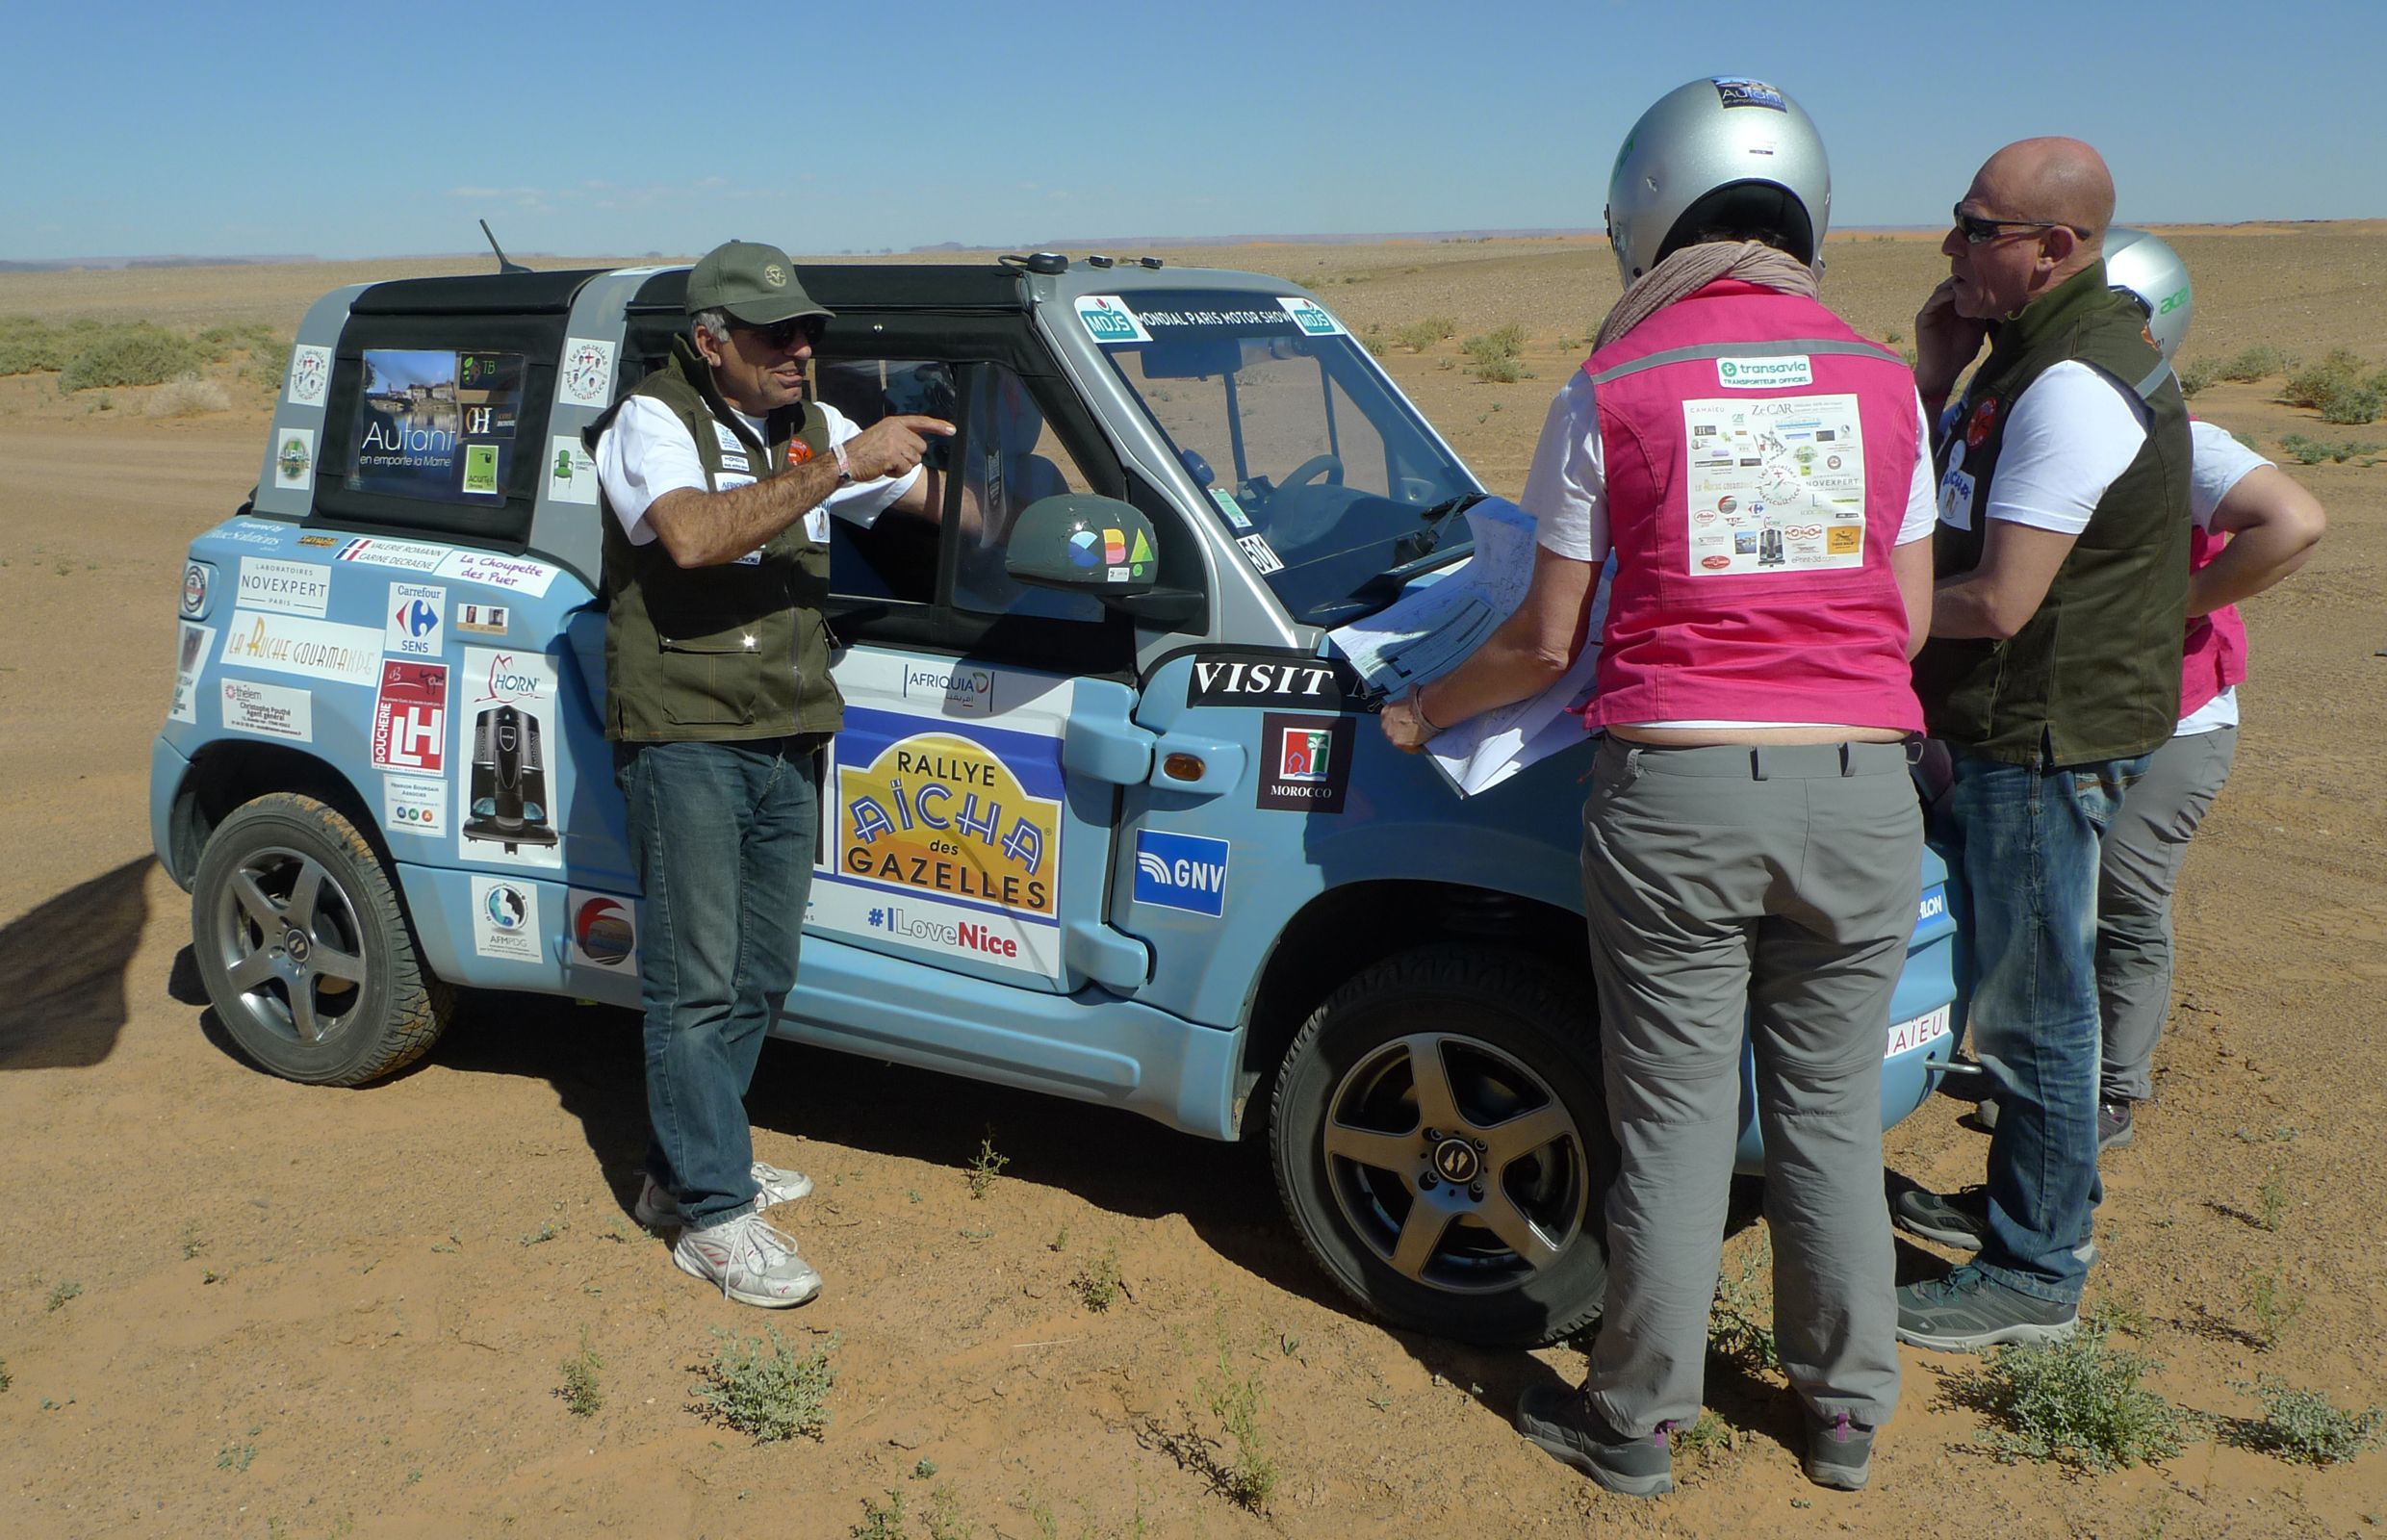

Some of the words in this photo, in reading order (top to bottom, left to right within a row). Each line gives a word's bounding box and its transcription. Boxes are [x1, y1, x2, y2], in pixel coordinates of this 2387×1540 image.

[1086, 315, 1131, 333] MDJS
[1134, 312, 1189, 327] MONDIAL
[1188, 311, 1223, 325] PARIS
[1223, 311, 1259, 324] MOTOR
[1260, 311, 1292, 323] SHOW
[1299, 311, 1329, 327] MDJS
[1740, 361, 1807, 374] transavia
[361, 421, 456, 451] Autant
[360, 455, 373, 465] en
[373, 455, 413, 468] emporte
[413, 455, 423, 466] la
[424, 456, 452, 468] Marne
[359, 552, 389, 564] CARINE
[389, 556, 435, 570] DECRAENE
[1240, 535, 1282, 573] 501
[255, 563, 314, 576] LABORATOIRES
[459, 554, 475, 564] La
[479, 557, 544, 577] Choupette
[242, 575, 327, 598] NOVEXPERT
[461, 568, 485, 579] des
[488, 572, 519, 586] Puer
[398, 585, 442, 599] Carrefour
[269, 598, 292, 606] PARIS
[401, 640, 429, 654] SENS
[495, 674, 537, 692] HORN
[909, 672, 974, 693] AFRIQUIA
[1194, 662, 1334, 695] VISIT
[375, 702, 392, 763] BOUCHERIE
[897, 751, 995, 787] RALLYE
[1270, 784, 1332, 799] MOROCCO
[847, 778, 1043, 877] AÏCHA
[929, 838, 960, 857] des
[847, 846, 1046, 910] GAZELLES
[1174, 859, 1224, 893] GNV
[868, 907, 1017, 958] #ILoveNice
[1885, 1012, 1943, 1056] AÏEU
